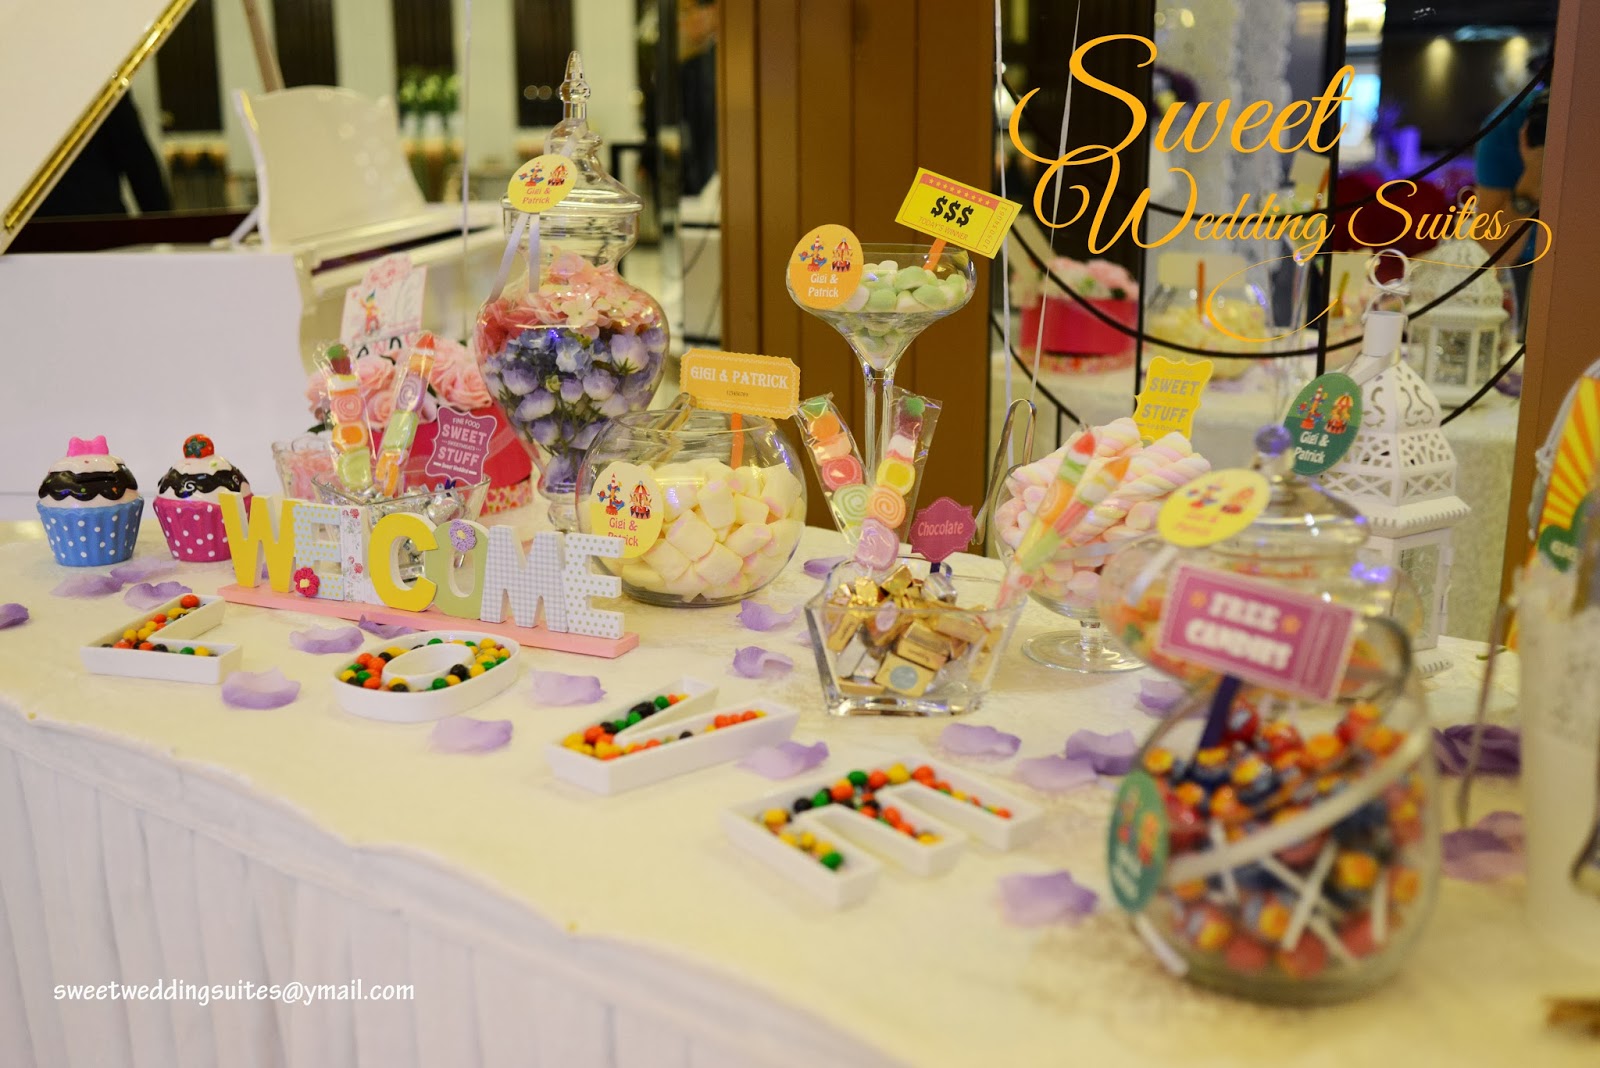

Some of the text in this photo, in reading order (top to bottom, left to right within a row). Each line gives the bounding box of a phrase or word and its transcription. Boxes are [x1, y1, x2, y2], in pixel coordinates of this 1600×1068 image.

[521, 196, 551, 205] Patrick
[930, 195, 975, 228] $$$
[810, 272, 839, 285] Gigi &
[807, 286, 839, 298] Patrick
[689, 365, 789, 390] GIGI & PATRICK
[1149, 376, 1201, 397] SWEET
[1141, 403, 1190, 423] STUFF
[441, 423, 487, 446] SWEET
[437, 446, 480, 467] STUFF
[608, 517, 639, 532] Gigi &
[917, 519, 965, 537] Chocolate
[218, 491, 626, 640] WELCOME
